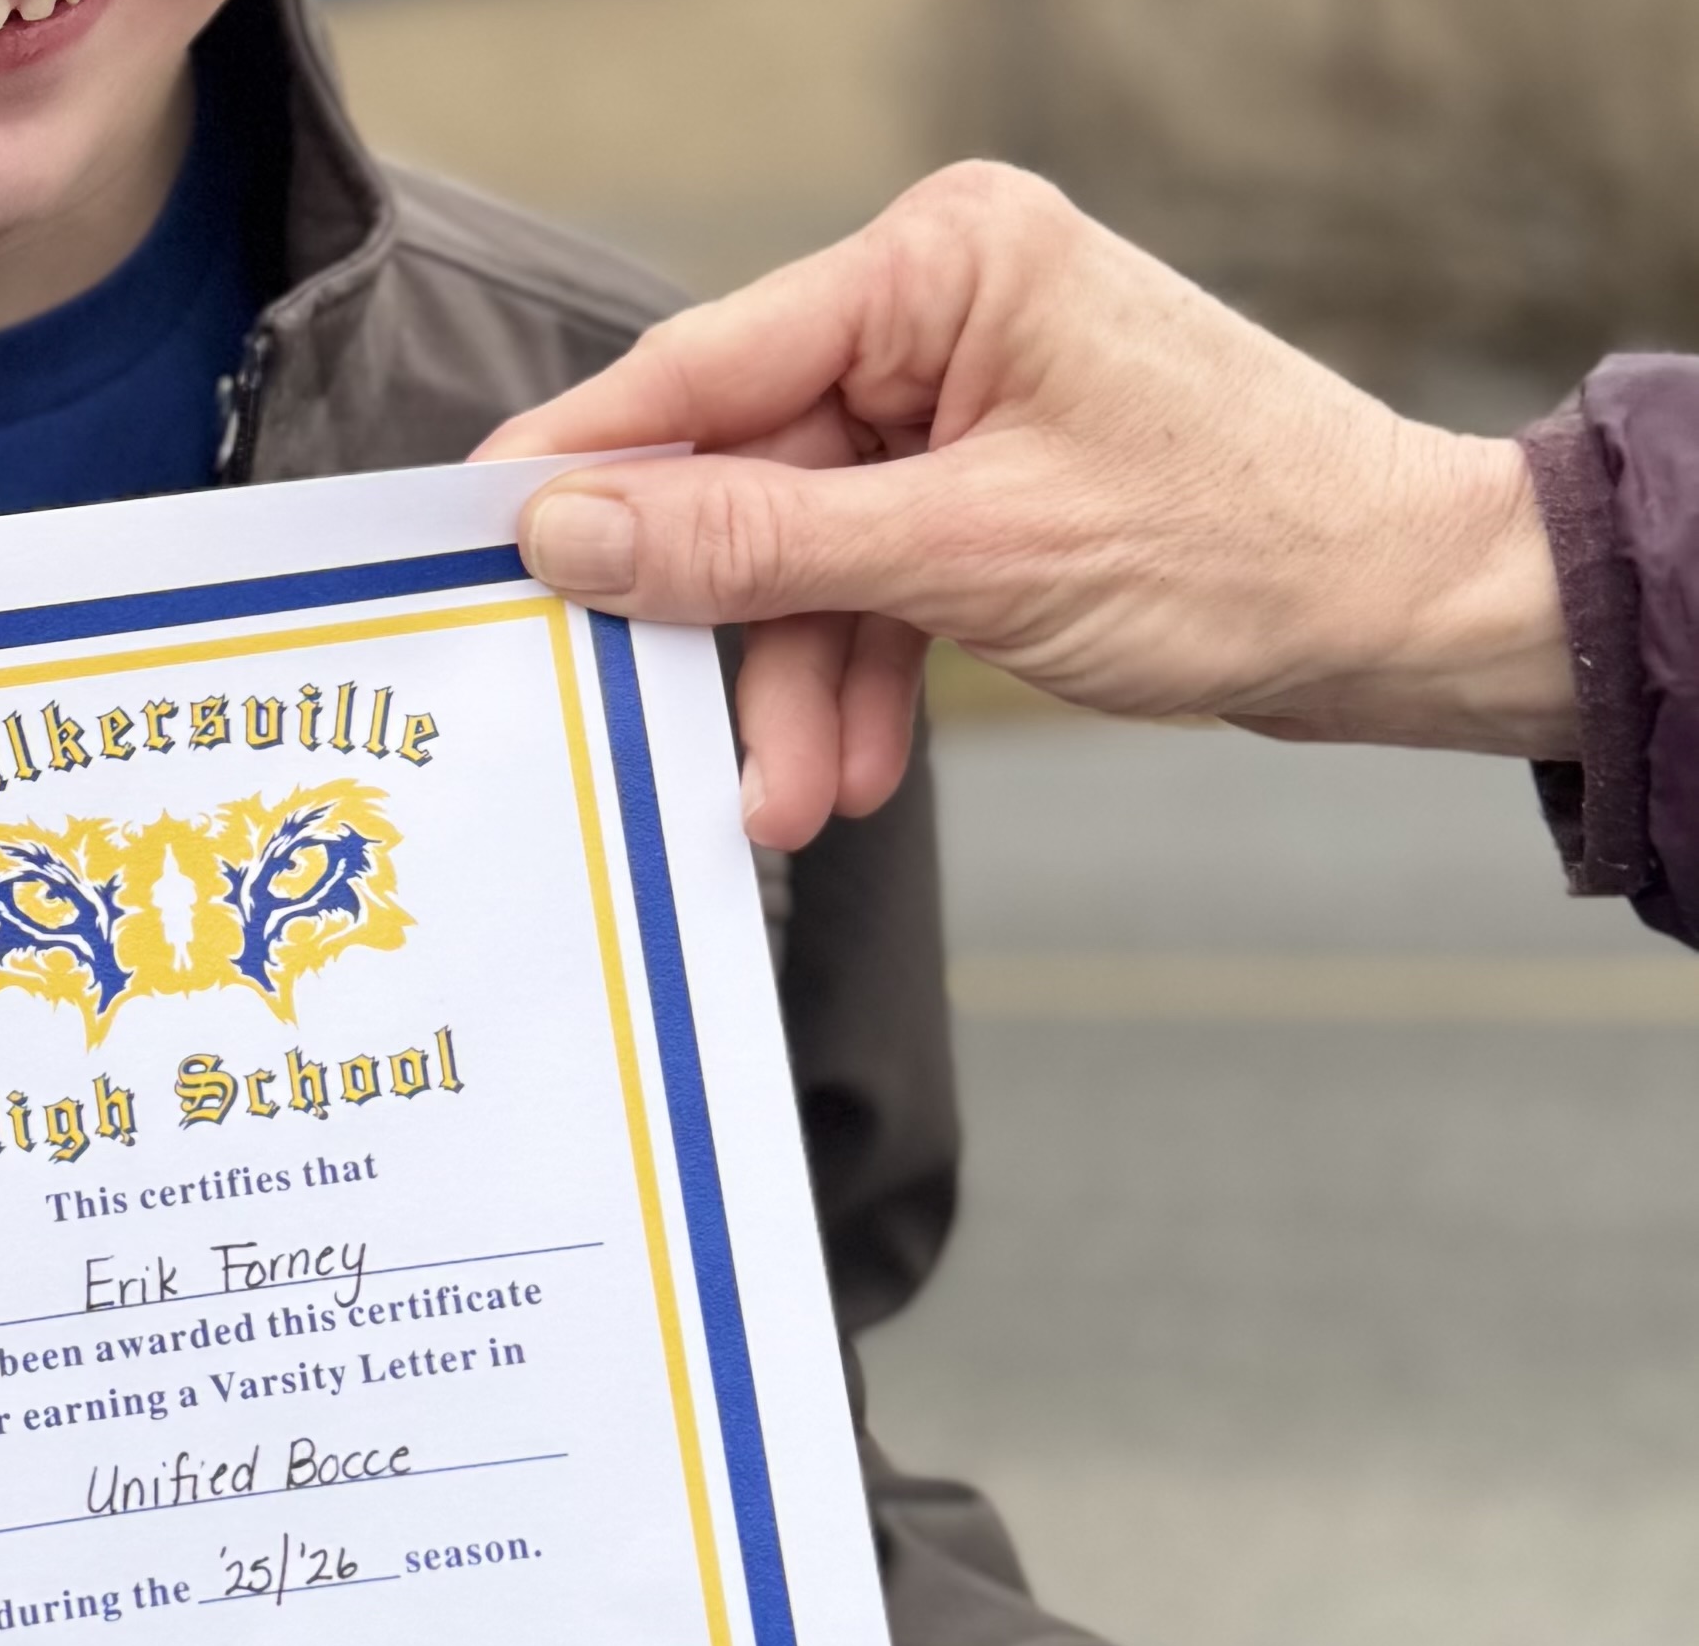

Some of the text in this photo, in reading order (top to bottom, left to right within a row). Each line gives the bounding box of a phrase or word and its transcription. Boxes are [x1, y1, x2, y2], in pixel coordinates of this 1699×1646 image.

[174, 1025, 465, 1129] School
[45, 1152, 379, 1223] This certifies that
[85, 1242, 366, 1312] Erik Forney
[95, 1312, 256, 1363] awarded
[267, 1303, 337, 1340] this
[347, 1279, 543, 1328] certificate
[23, 1387, 169, 1431] earning
[179, 1385, 199, 1409] a
[209, 1360, 347, 1404] Varsity
[356, 1345, 478, 1384] Letter
[489, 1337, 527, 1367] in
[87, 1437, 412, 1516] Unified Bocce
[133, 1575, 191, 1611] the
[220, 1533, 358, 1606] '25/'26
[405, 1534, 543, 1574] season.
